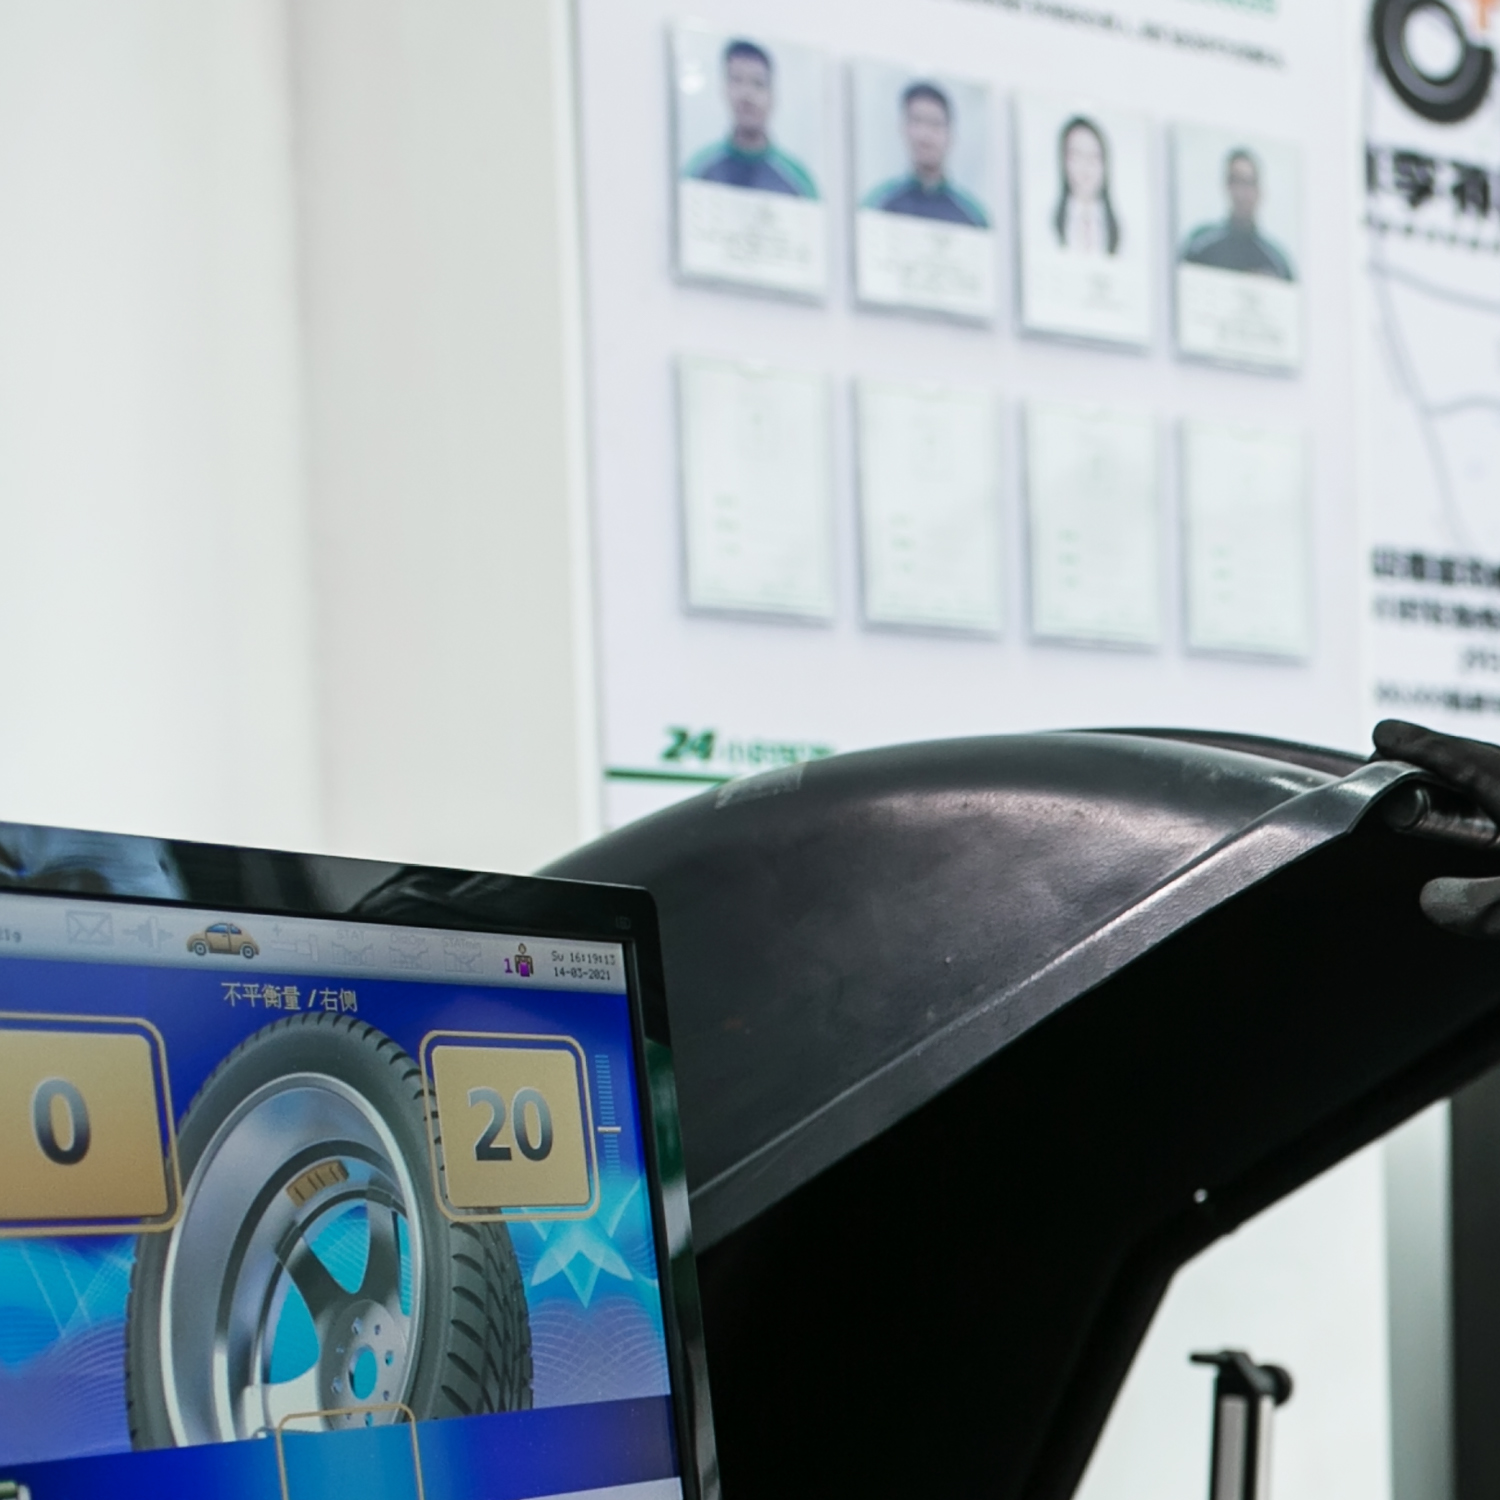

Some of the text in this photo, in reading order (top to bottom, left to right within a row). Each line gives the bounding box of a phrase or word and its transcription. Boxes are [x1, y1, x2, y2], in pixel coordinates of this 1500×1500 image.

[554, 967, 611, 980] 14-03-2021
[33, 1079, 92, 1166] 0
[466, 1086, 556, 1164] 20
